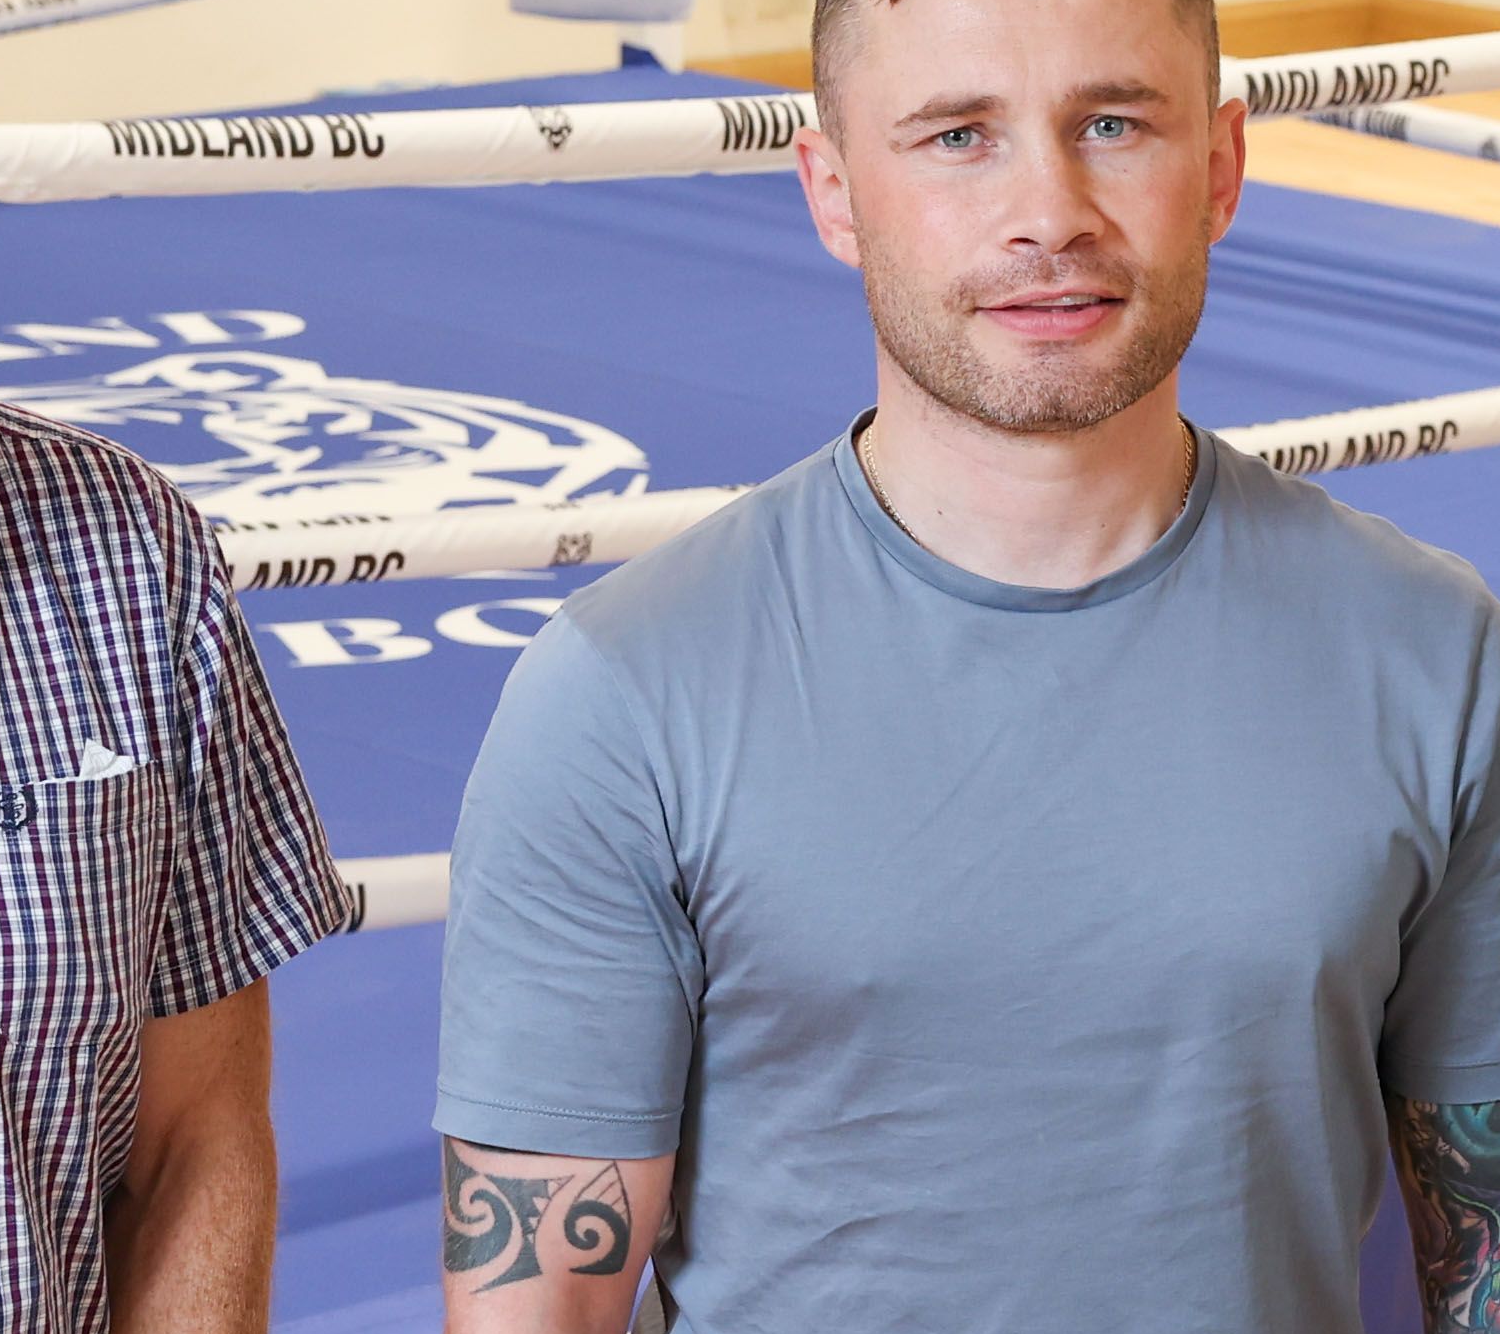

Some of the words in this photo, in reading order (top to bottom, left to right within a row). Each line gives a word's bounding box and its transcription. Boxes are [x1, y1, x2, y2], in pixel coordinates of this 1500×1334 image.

[1246, 63, 1398, 117] MIDLAND
[1406, 57, 1451, 101] BC
[103, 114, 316, 161] MIDLAND
[328, 111, 388, 159] BC
[229, 556, 338, 593] AND
[257, 597, 562, 668] BO
